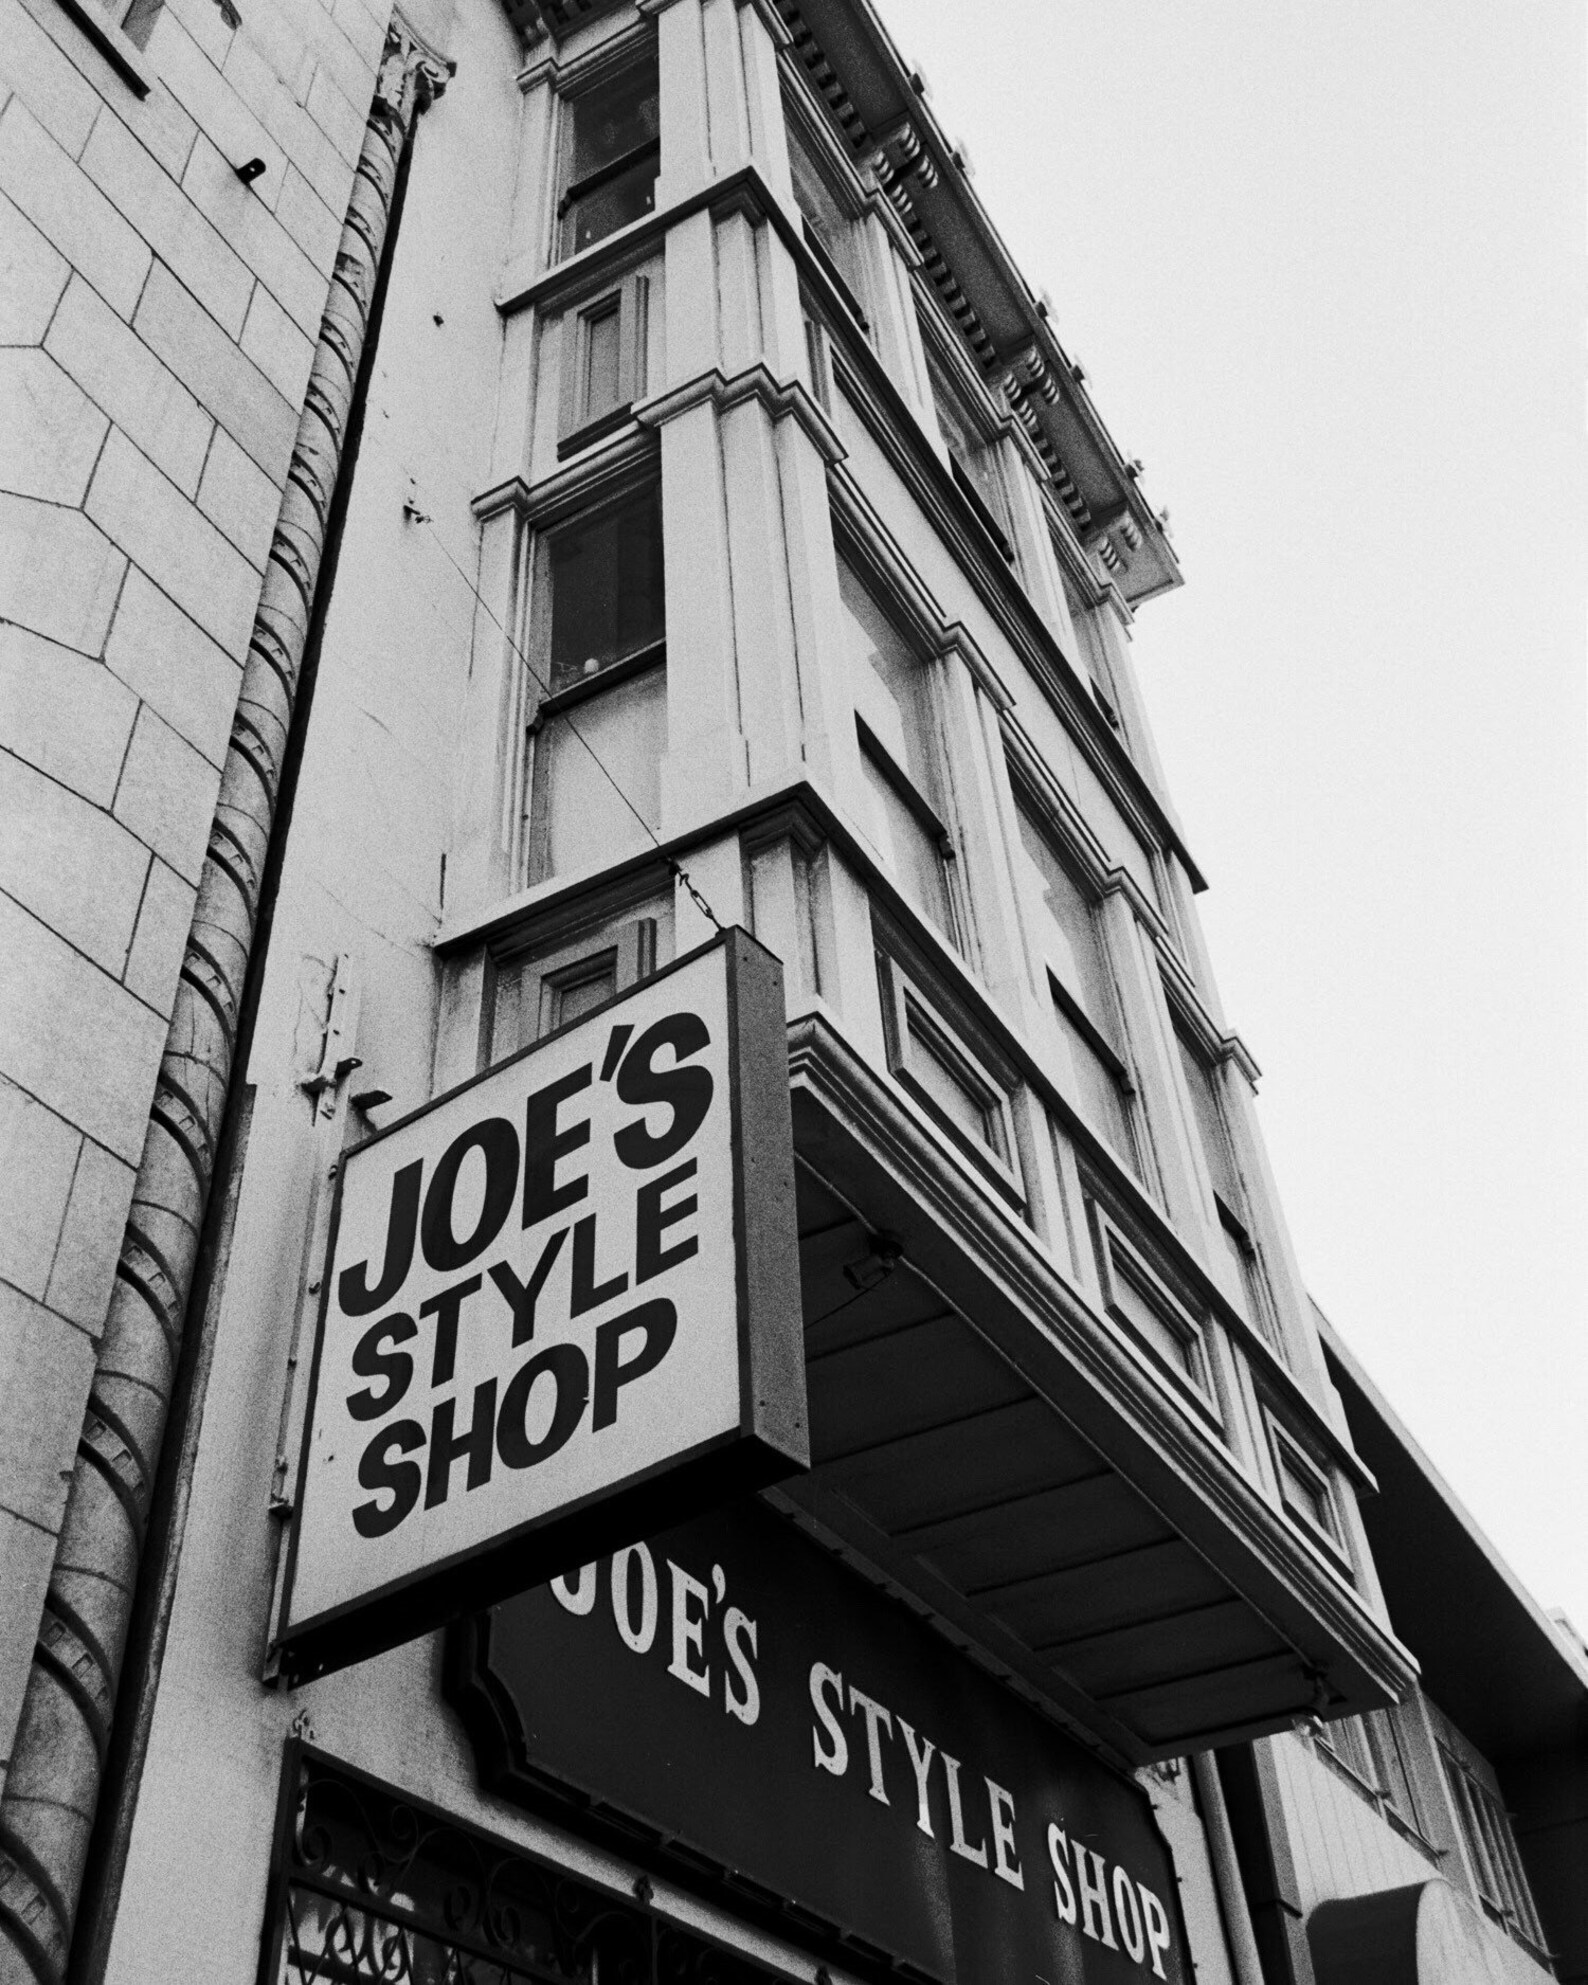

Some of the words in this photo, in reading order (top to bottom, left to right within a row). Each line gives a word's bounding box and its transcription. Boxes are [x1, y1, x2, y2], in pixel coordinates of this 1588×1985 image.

[338, 1012, 714, 1317] JOE'S
[346, 1157, 699, 1422] STYLE
[352, 1297, 678, 1539] SHOP
[809, 1662, 1025, 1891] STYLE
[1047, 1822, 1171, 1981] SHOP
